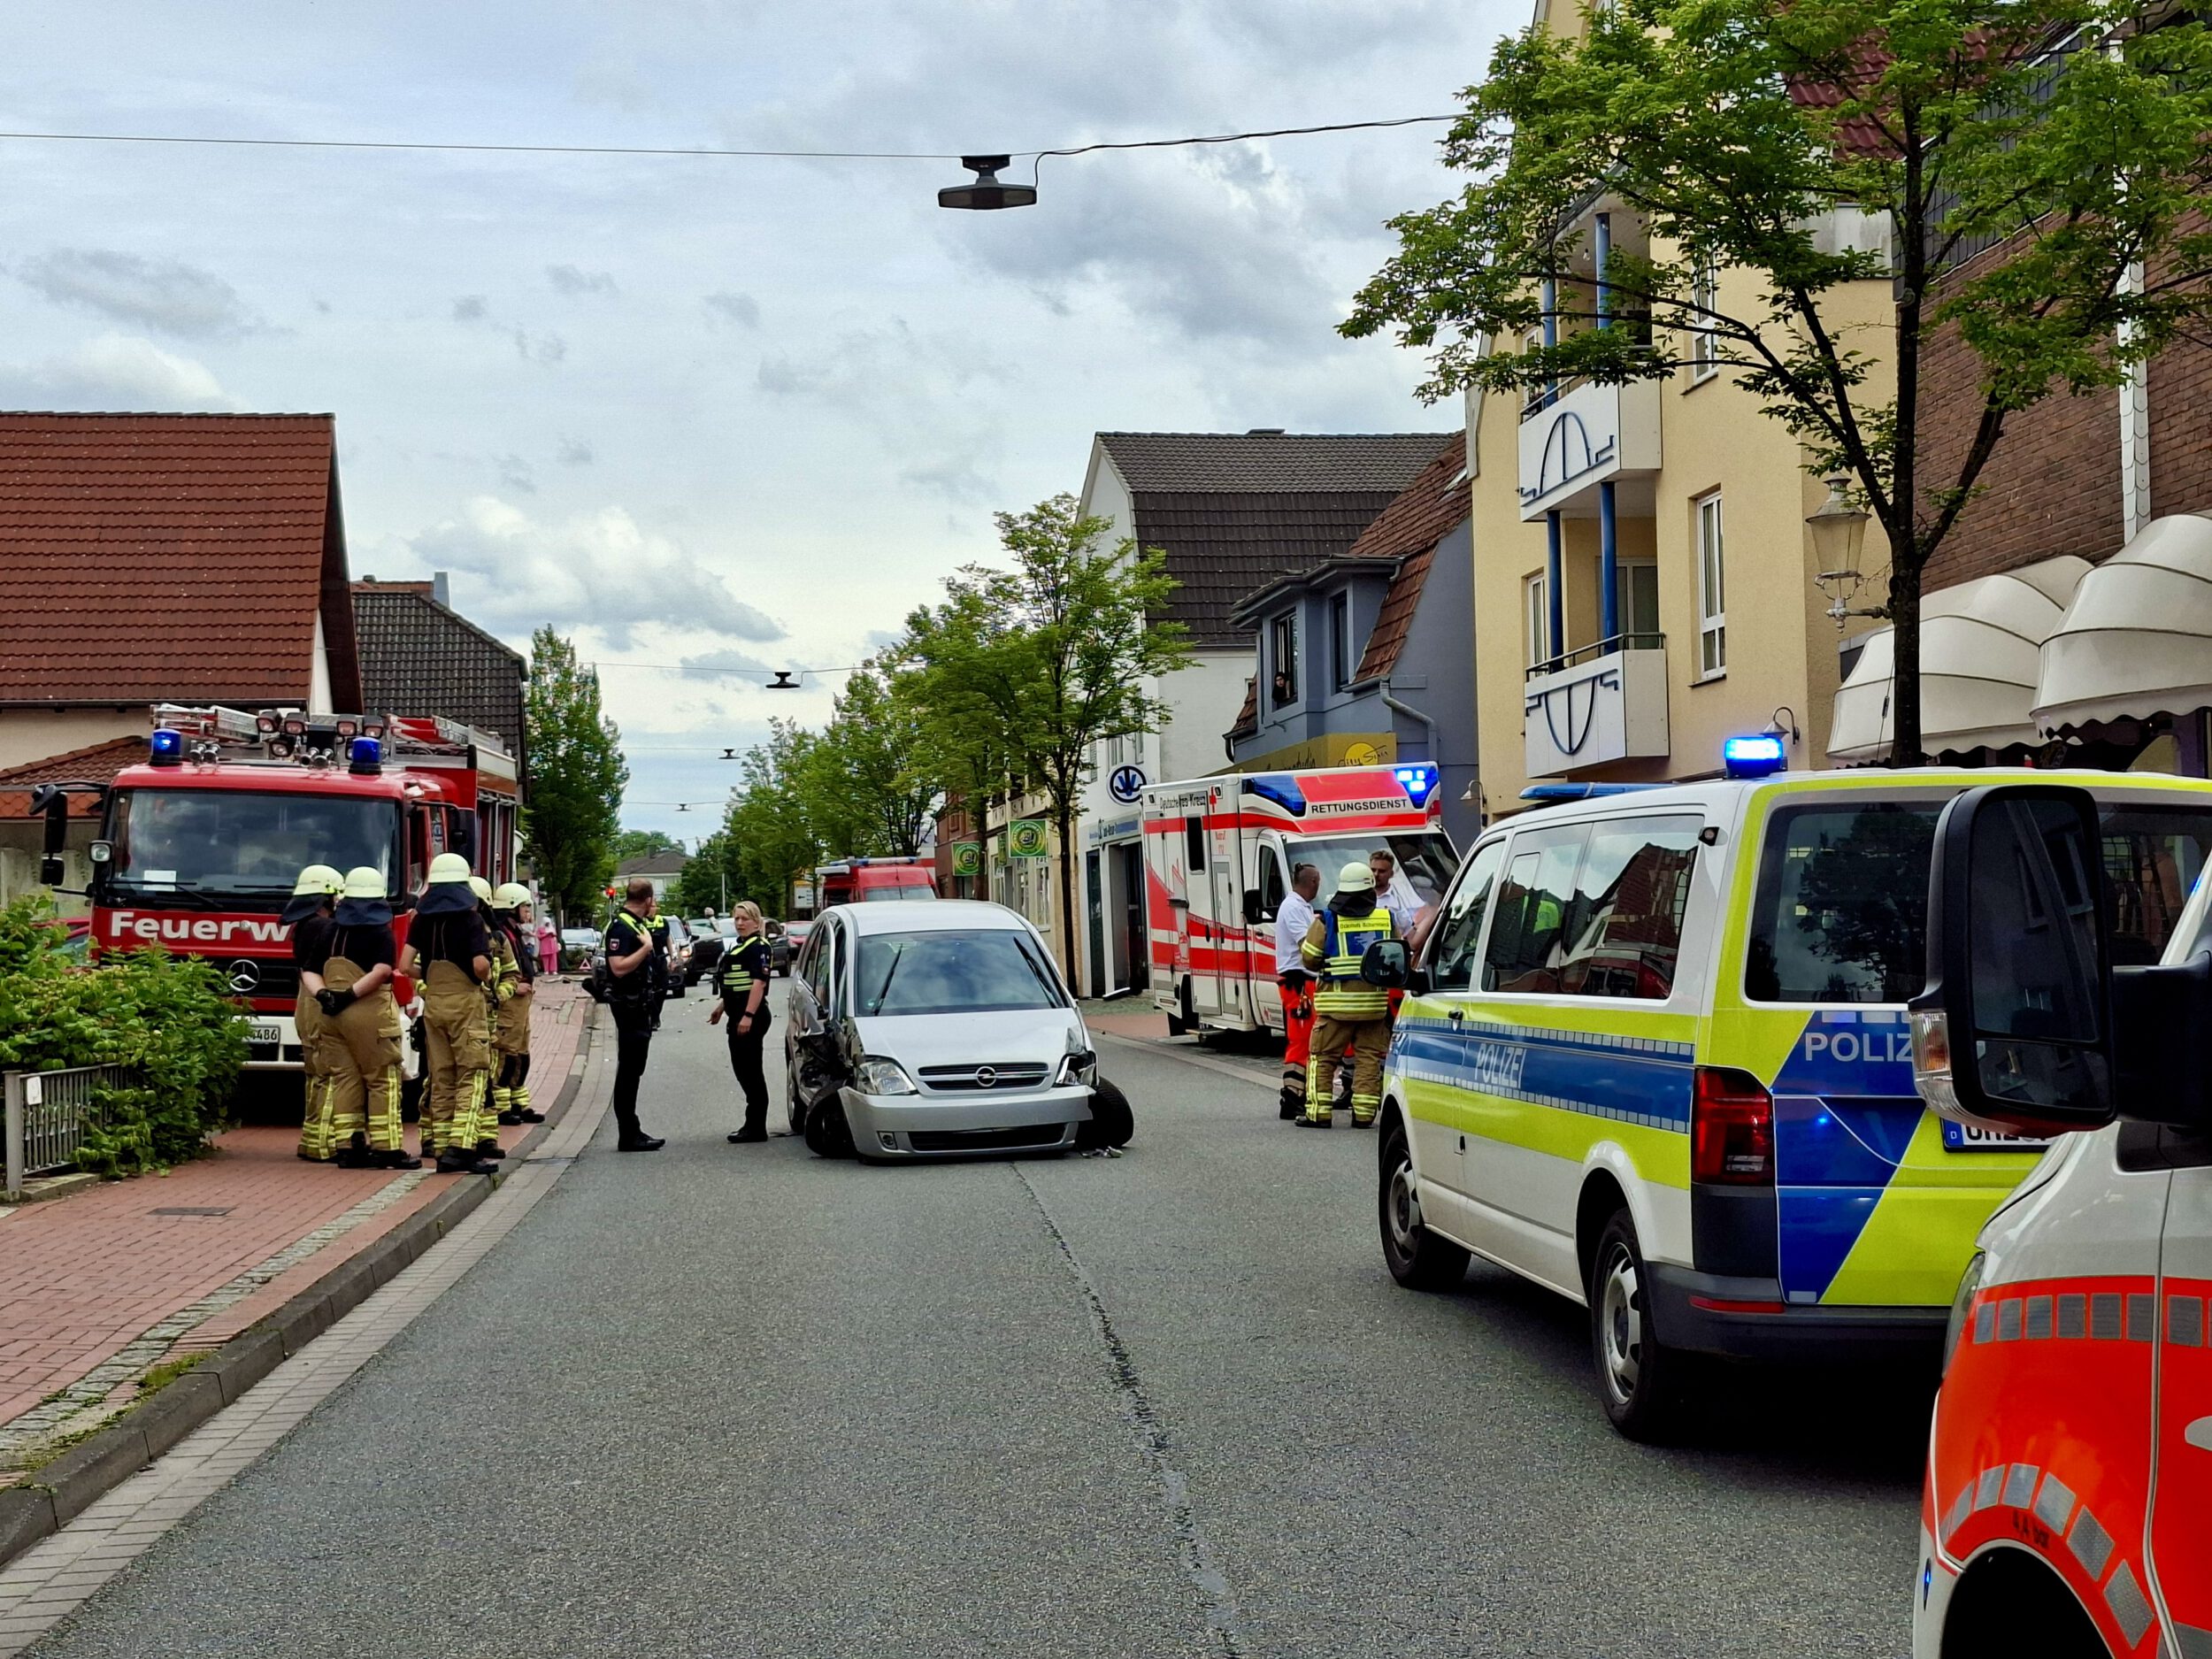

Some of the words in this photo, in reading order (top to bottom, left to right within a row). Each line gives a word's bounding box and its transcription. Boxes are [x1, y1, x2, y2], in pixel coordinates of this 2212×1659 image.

[1311, 799, 1408, 814] RETTUNGSDIENST
[1475, 1043, 1527, 1089] POLIZEI
[1950, 1131, 1958, 1140] D
